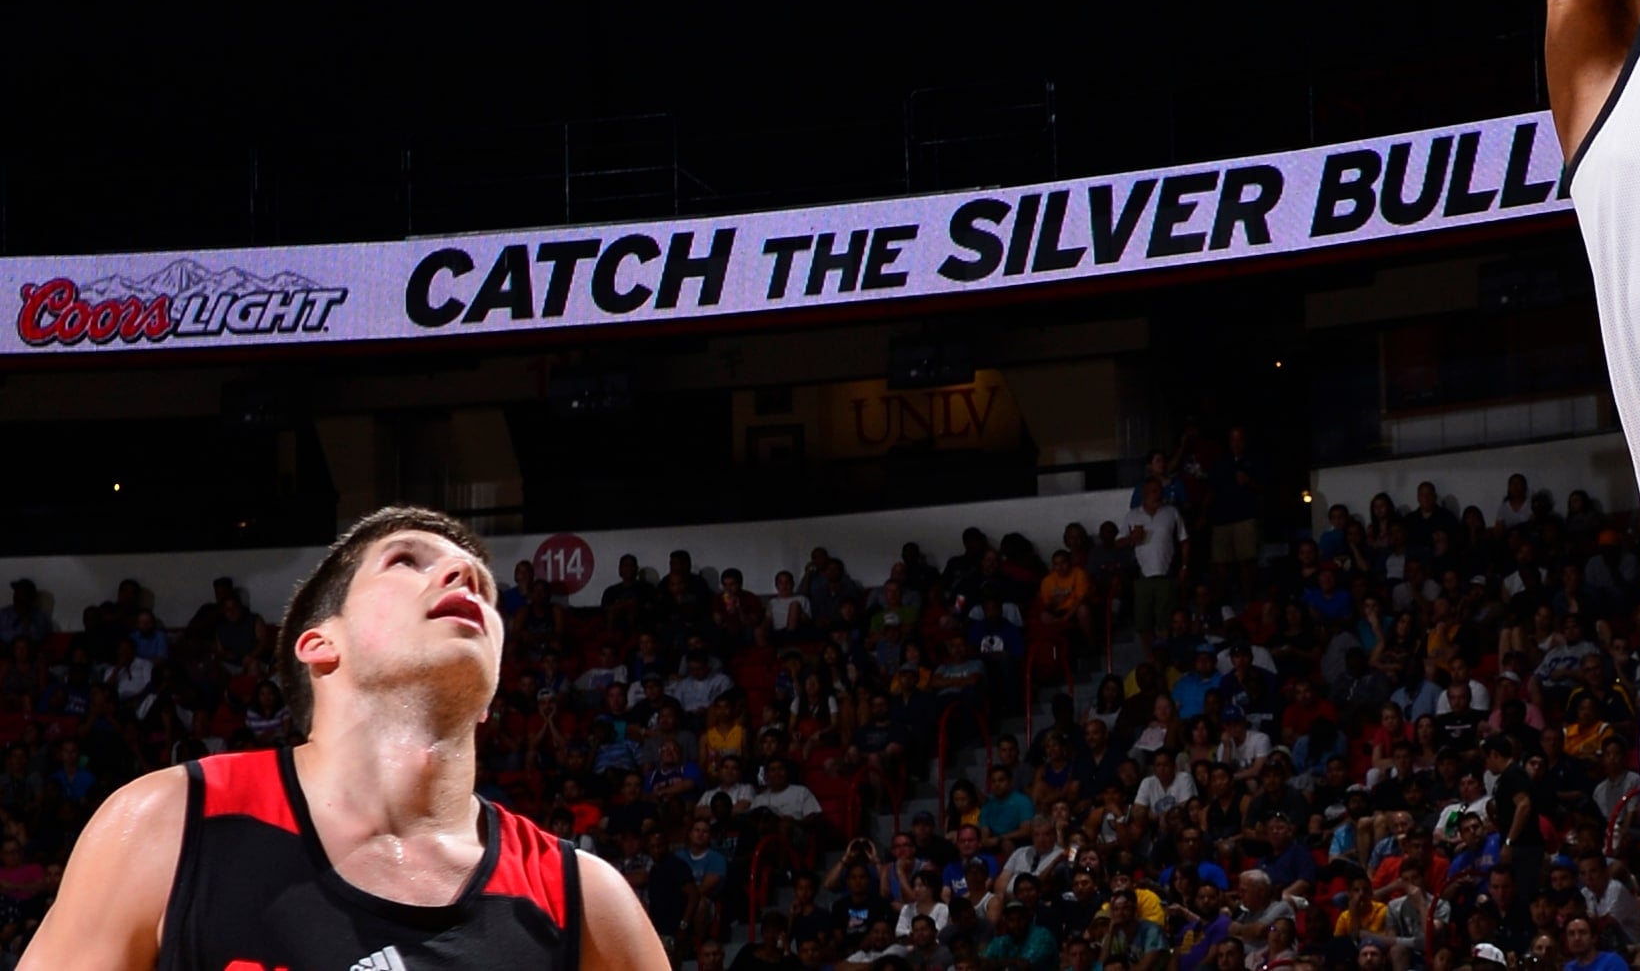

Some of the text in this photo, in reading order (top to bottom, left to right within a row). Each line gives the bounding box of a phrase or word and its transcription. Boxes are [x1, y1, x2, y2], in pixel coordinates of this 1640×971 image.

[405, 122, 1571, 328] CATCH THE SILVER BULL
[18, 278, 348, 347] Coors LIGHT
[850, 385, 1002, 445] UNLV
[541, 547, 585, 583] 114
